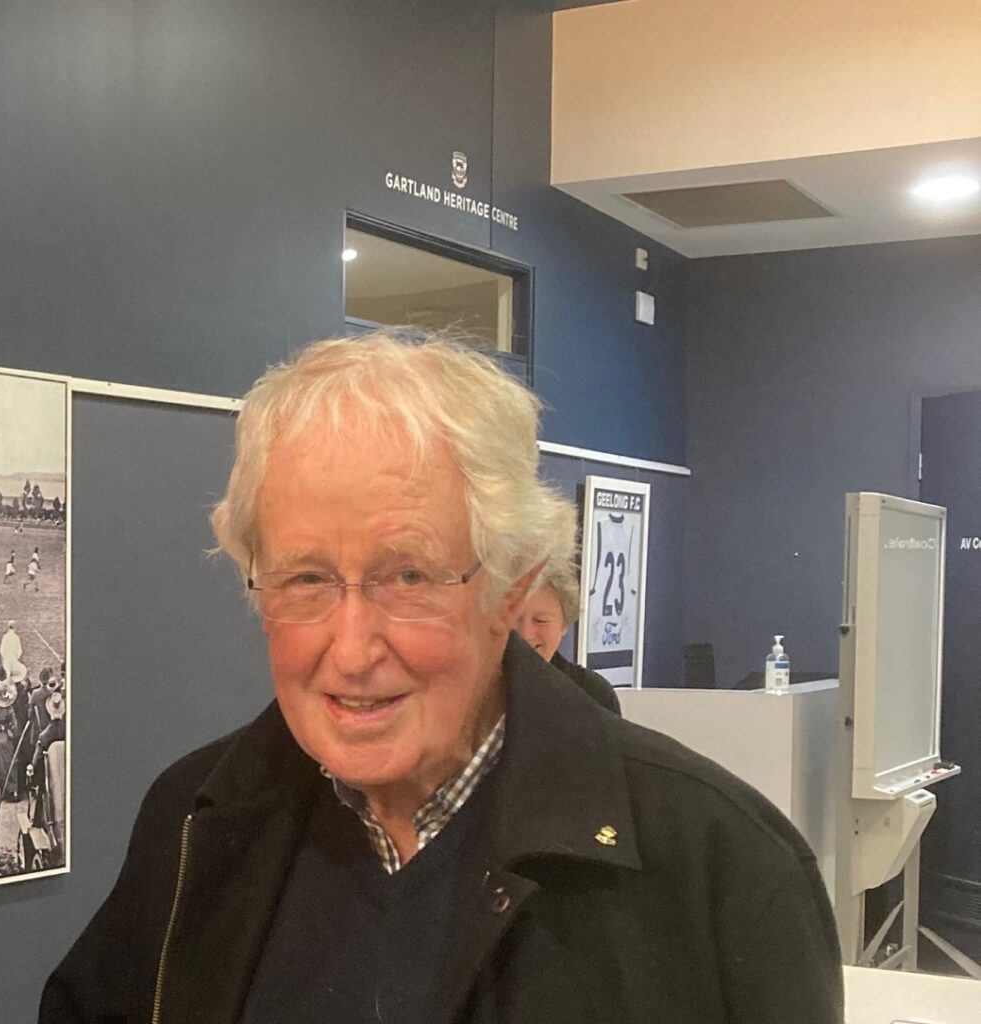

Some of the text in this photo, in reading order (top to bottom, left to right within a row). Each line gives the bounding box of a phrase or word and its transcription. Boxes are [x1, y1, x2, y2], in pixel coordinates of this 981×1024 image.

[385, 172, 519, 231] GARTLAND HERITAGE CENTRE
[596, 491, 629, 510] GEELONG
[960, 537, 972, 550] AV
[602, 551, 626, 617] 23
